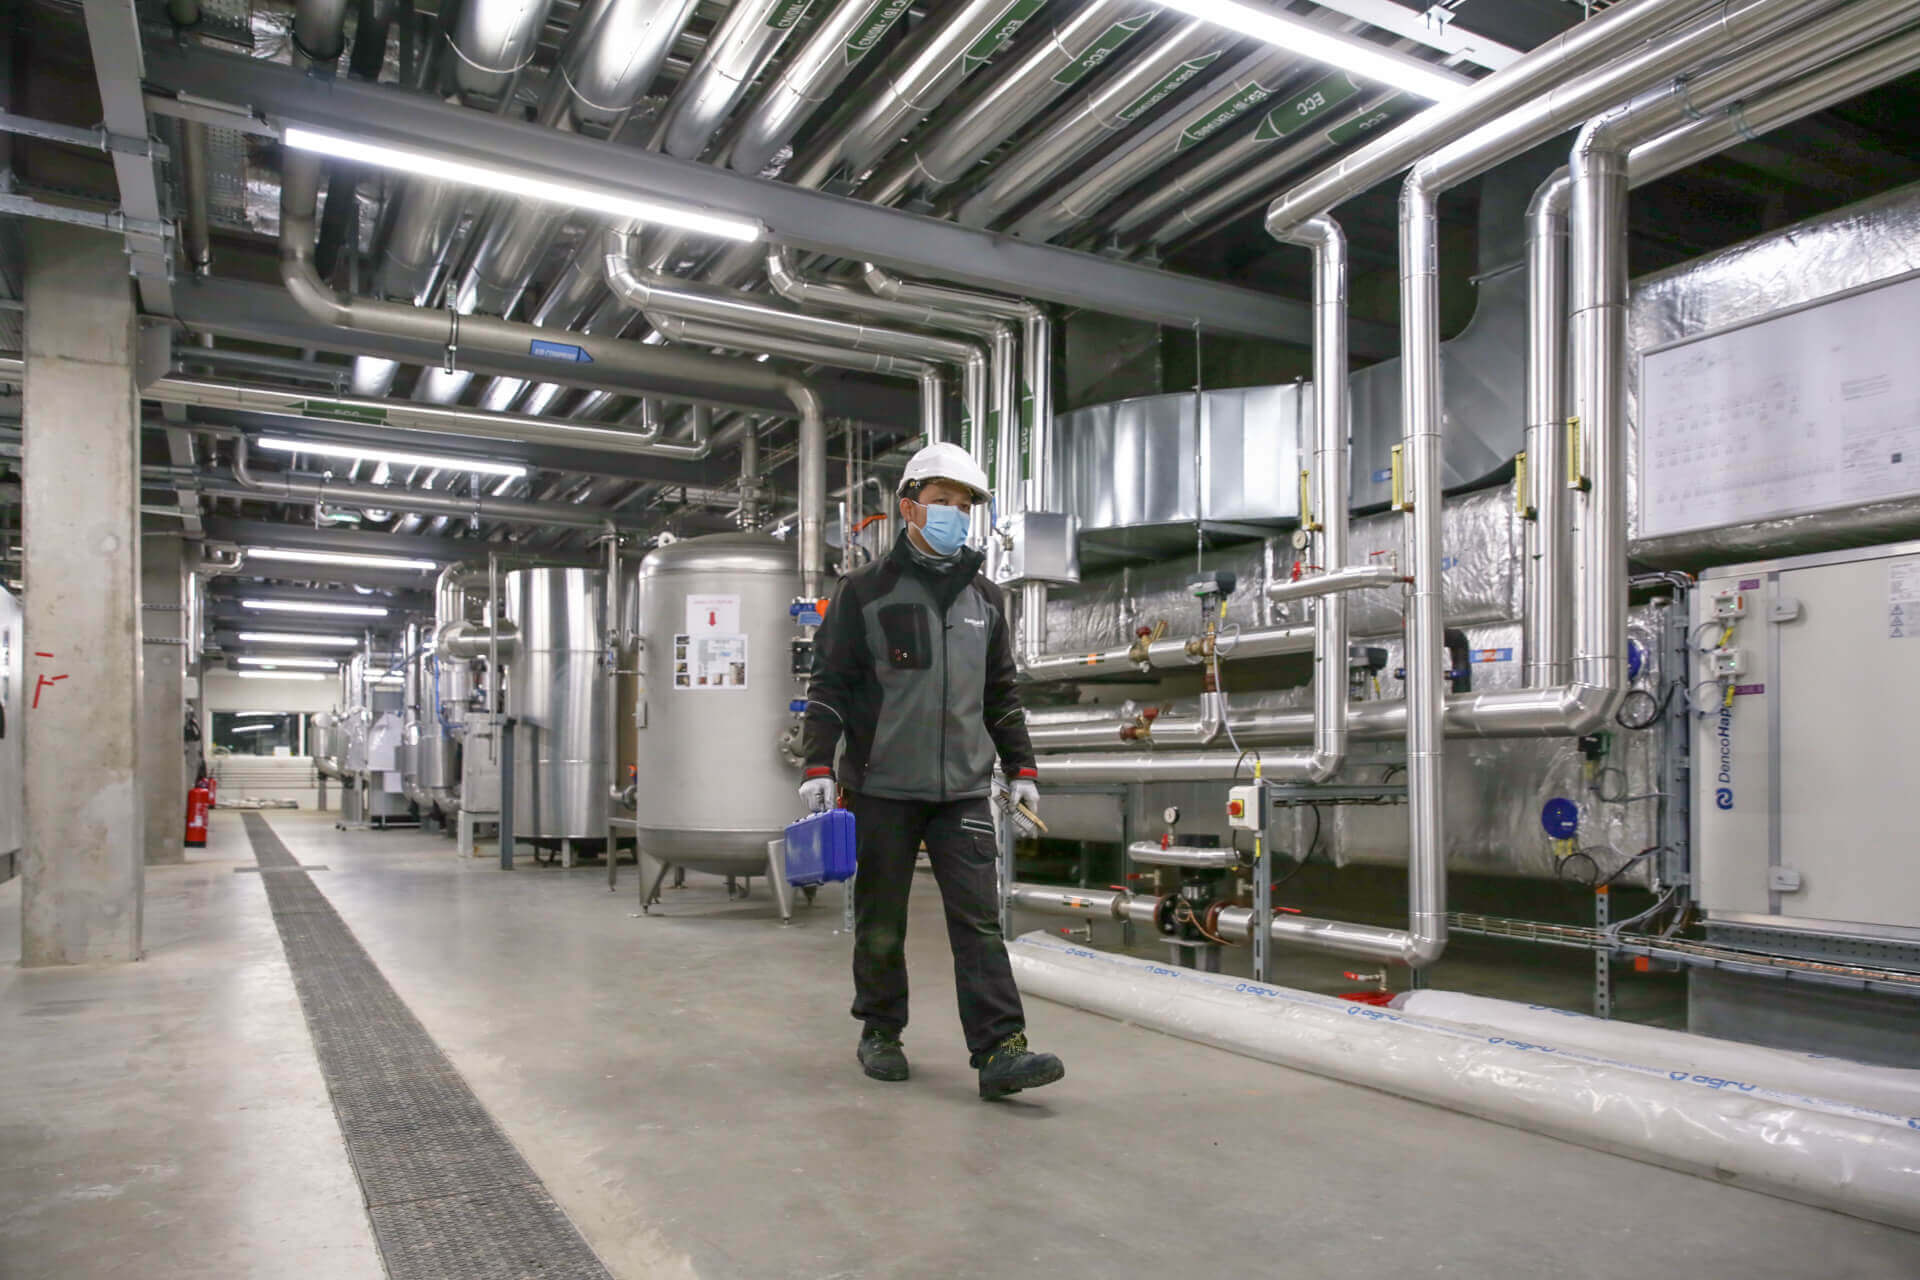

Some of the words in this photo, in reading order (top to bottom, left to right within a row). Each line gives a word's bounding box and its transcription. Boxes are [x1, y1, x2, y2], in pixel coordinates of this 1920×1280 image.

[994, 19, 1023, 40] ECC
[1081, 47, 1110, 68] ECC
[1295, 90, 1325, 116] ECC
[1717, 690, 1732, 784] DencoHap
[1247, 986, 1279, 997] agru
[1361, 1009, 1401, 1021] agru
[1505, 1040, 1556, 1052] agru
[1692, 1075, 1757, 1091] agru
